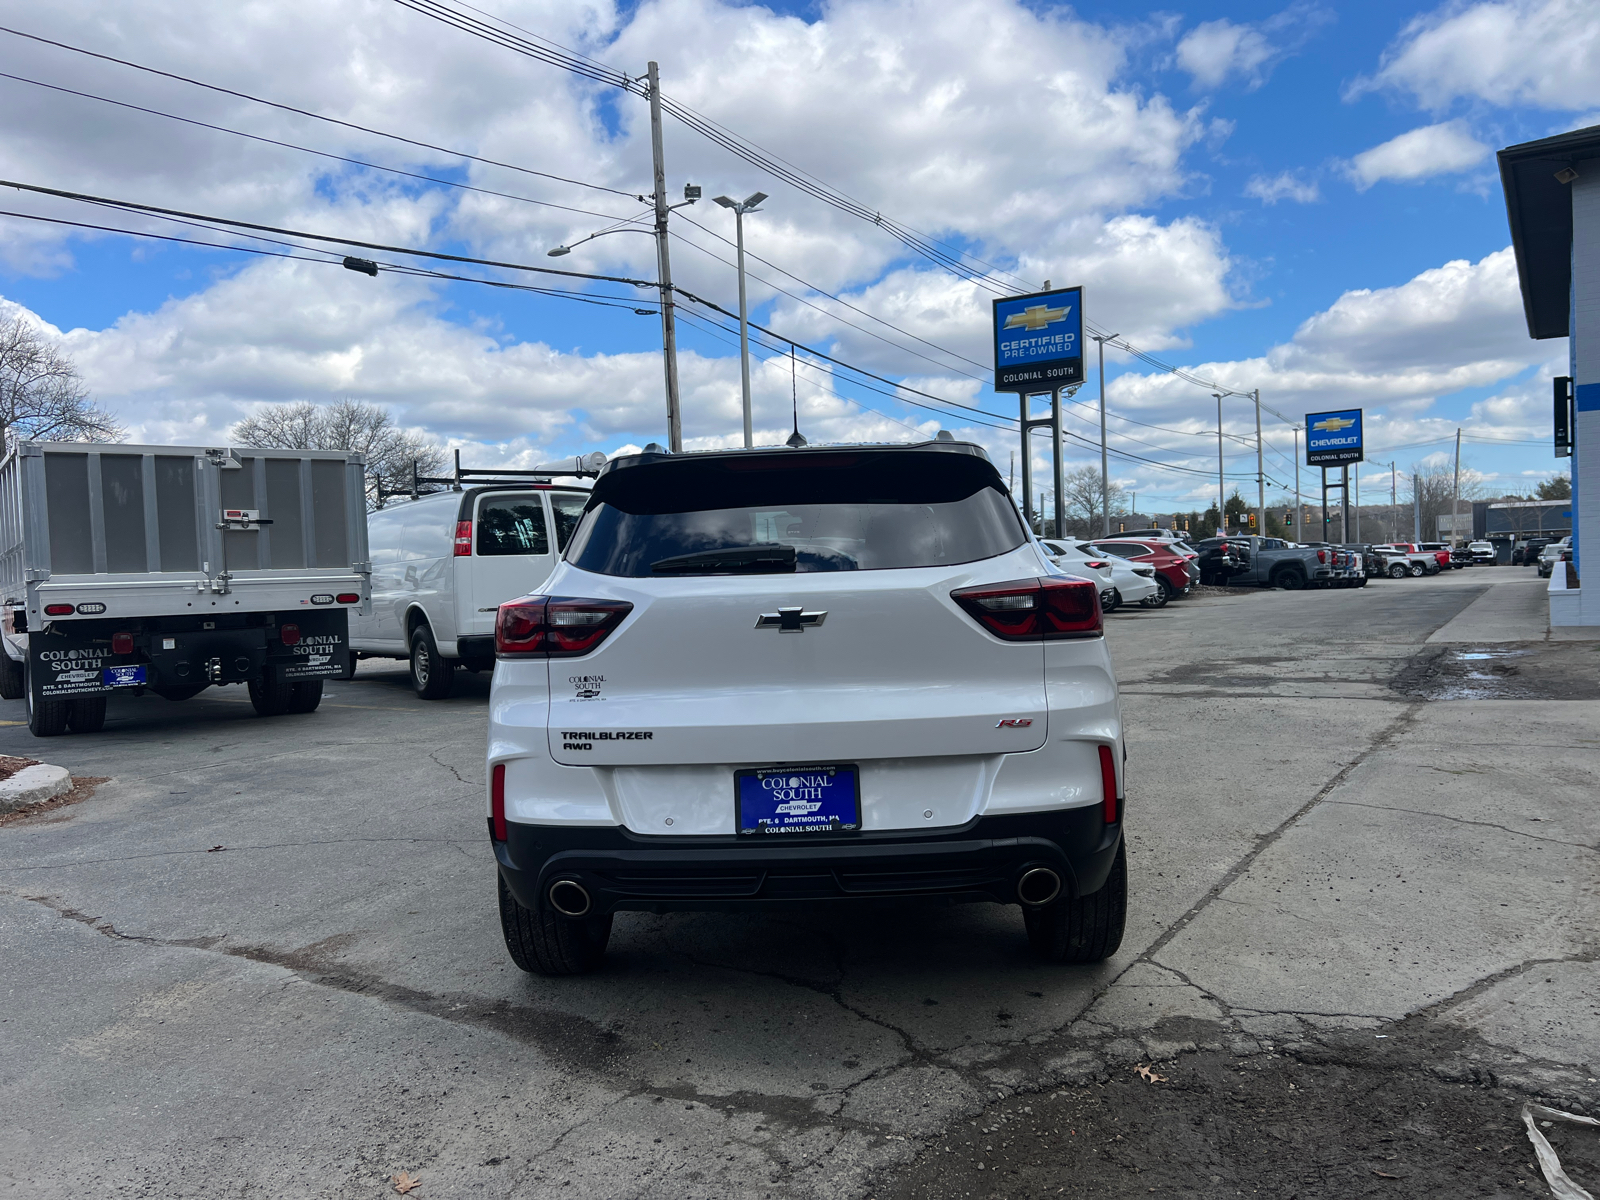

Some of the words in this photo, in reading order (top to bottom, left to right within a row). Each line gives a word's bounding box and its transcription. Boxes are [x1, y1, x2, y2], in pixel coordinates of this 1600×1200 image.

[1001, 333, 1075, 350] CERTIFIED
[1004, 343, 1071, 358] PRE-OWNED
[1003, 371, 1042, 382] COLONIAL
[1047, 367, 1074, 378] SOUTH
[1310, 437, 1358, 446] CHEVROLET
[40, 648, 112, 660] COLONIAL
[293, 645, 333, 654] SOUTH
[52, 659, 102, 670] SOUTH
[60, 672, 96, 680] CHEVROLET
[568, 675, 606, 683] COLONIAL
[995, 718, 1033, 728] RS
[561, 732, 653, 740] TRAILBLAZER
[757, 766, 836, 774] www.buycolonialsouth.com
[762, 776, 832, 789] COLONIAL
[773, 788, 822, 801] SOUTH
[784, 815, 828, 824] DARTMOUTH,
[765, 826, 804, 834] COLONIAL
